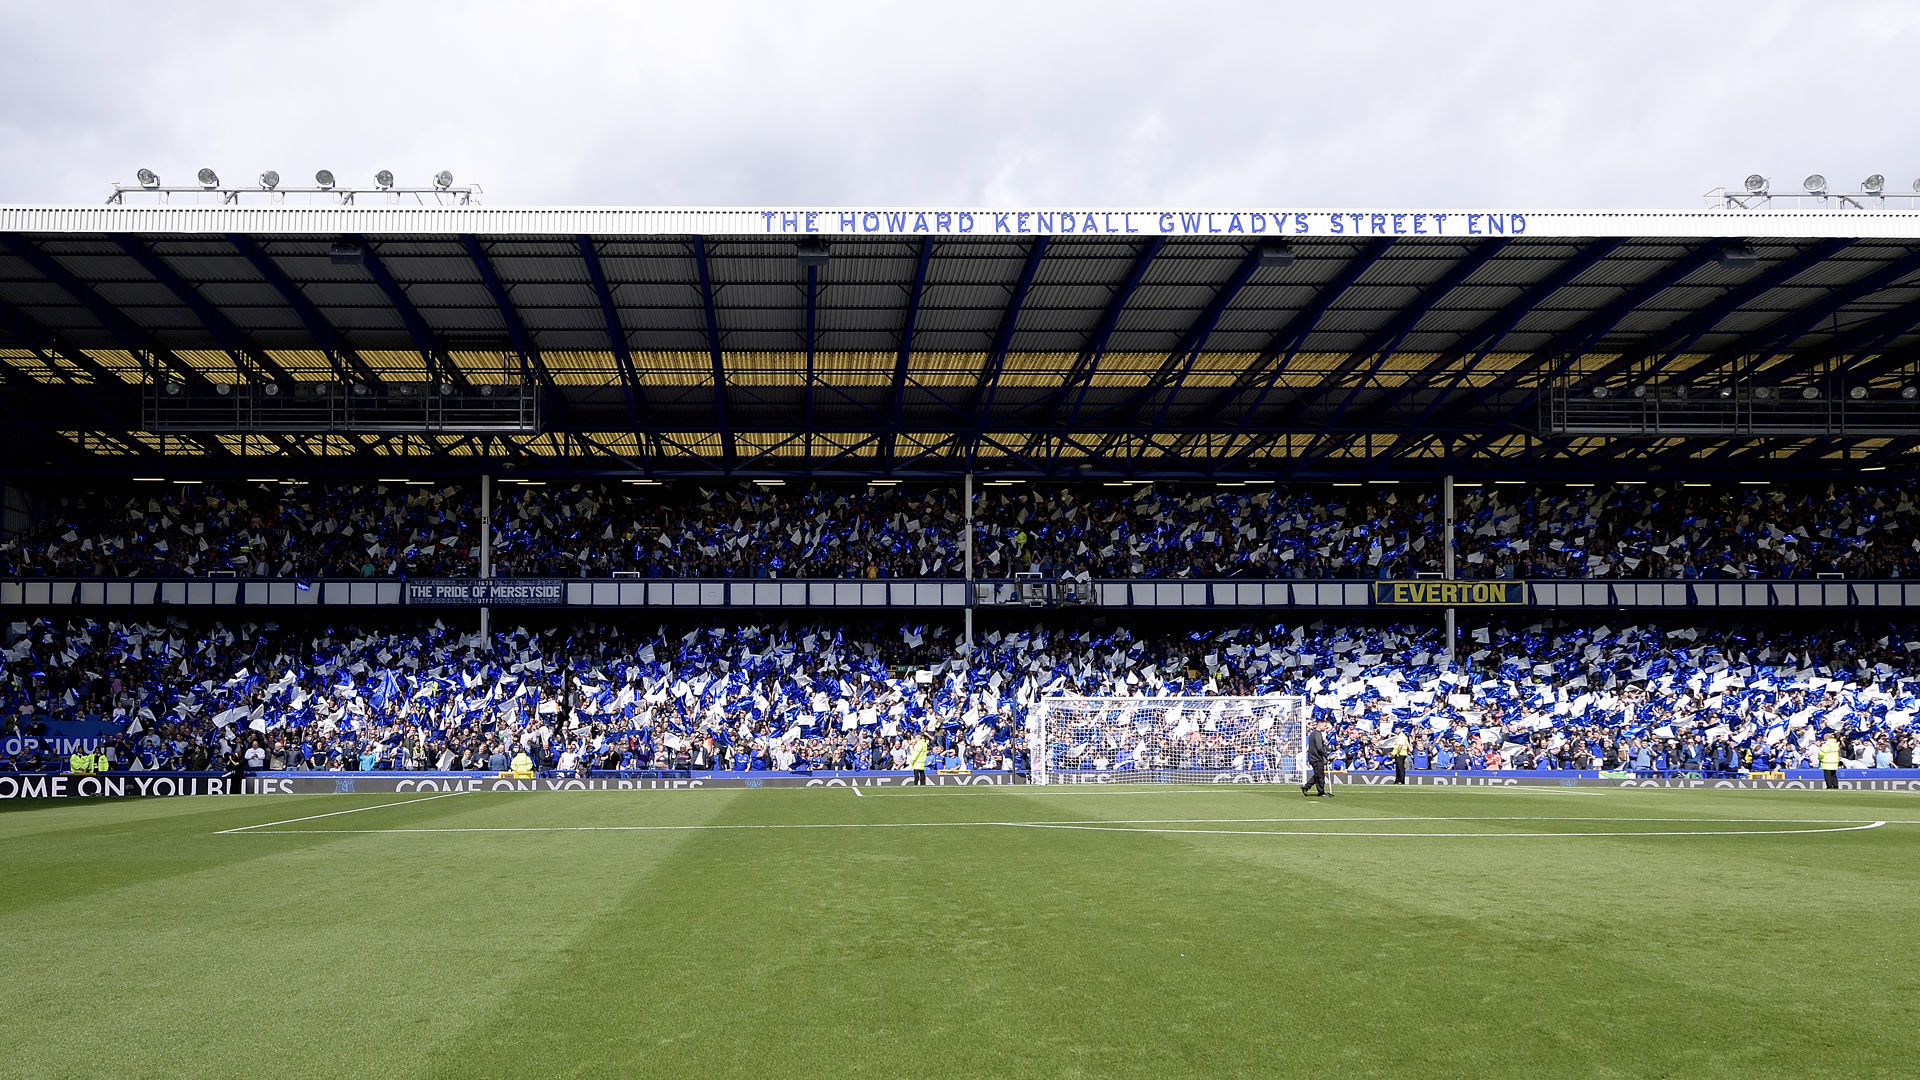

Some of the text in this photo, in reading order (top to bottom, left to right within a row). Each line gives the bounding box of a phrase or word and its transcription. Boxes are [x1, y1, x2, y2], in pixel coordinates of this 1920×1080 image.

[761, 212, 1527, 234] THE HOWARD KENDALL GWLADYS STREET END
[411, 586, 561, 598] THE PRIDE OF MERSEYSIDE
[1394, 583, 1506, 602] EVERTON
[78, 776, 125, 797] ON
[135, 777, 197, 796] YOU
